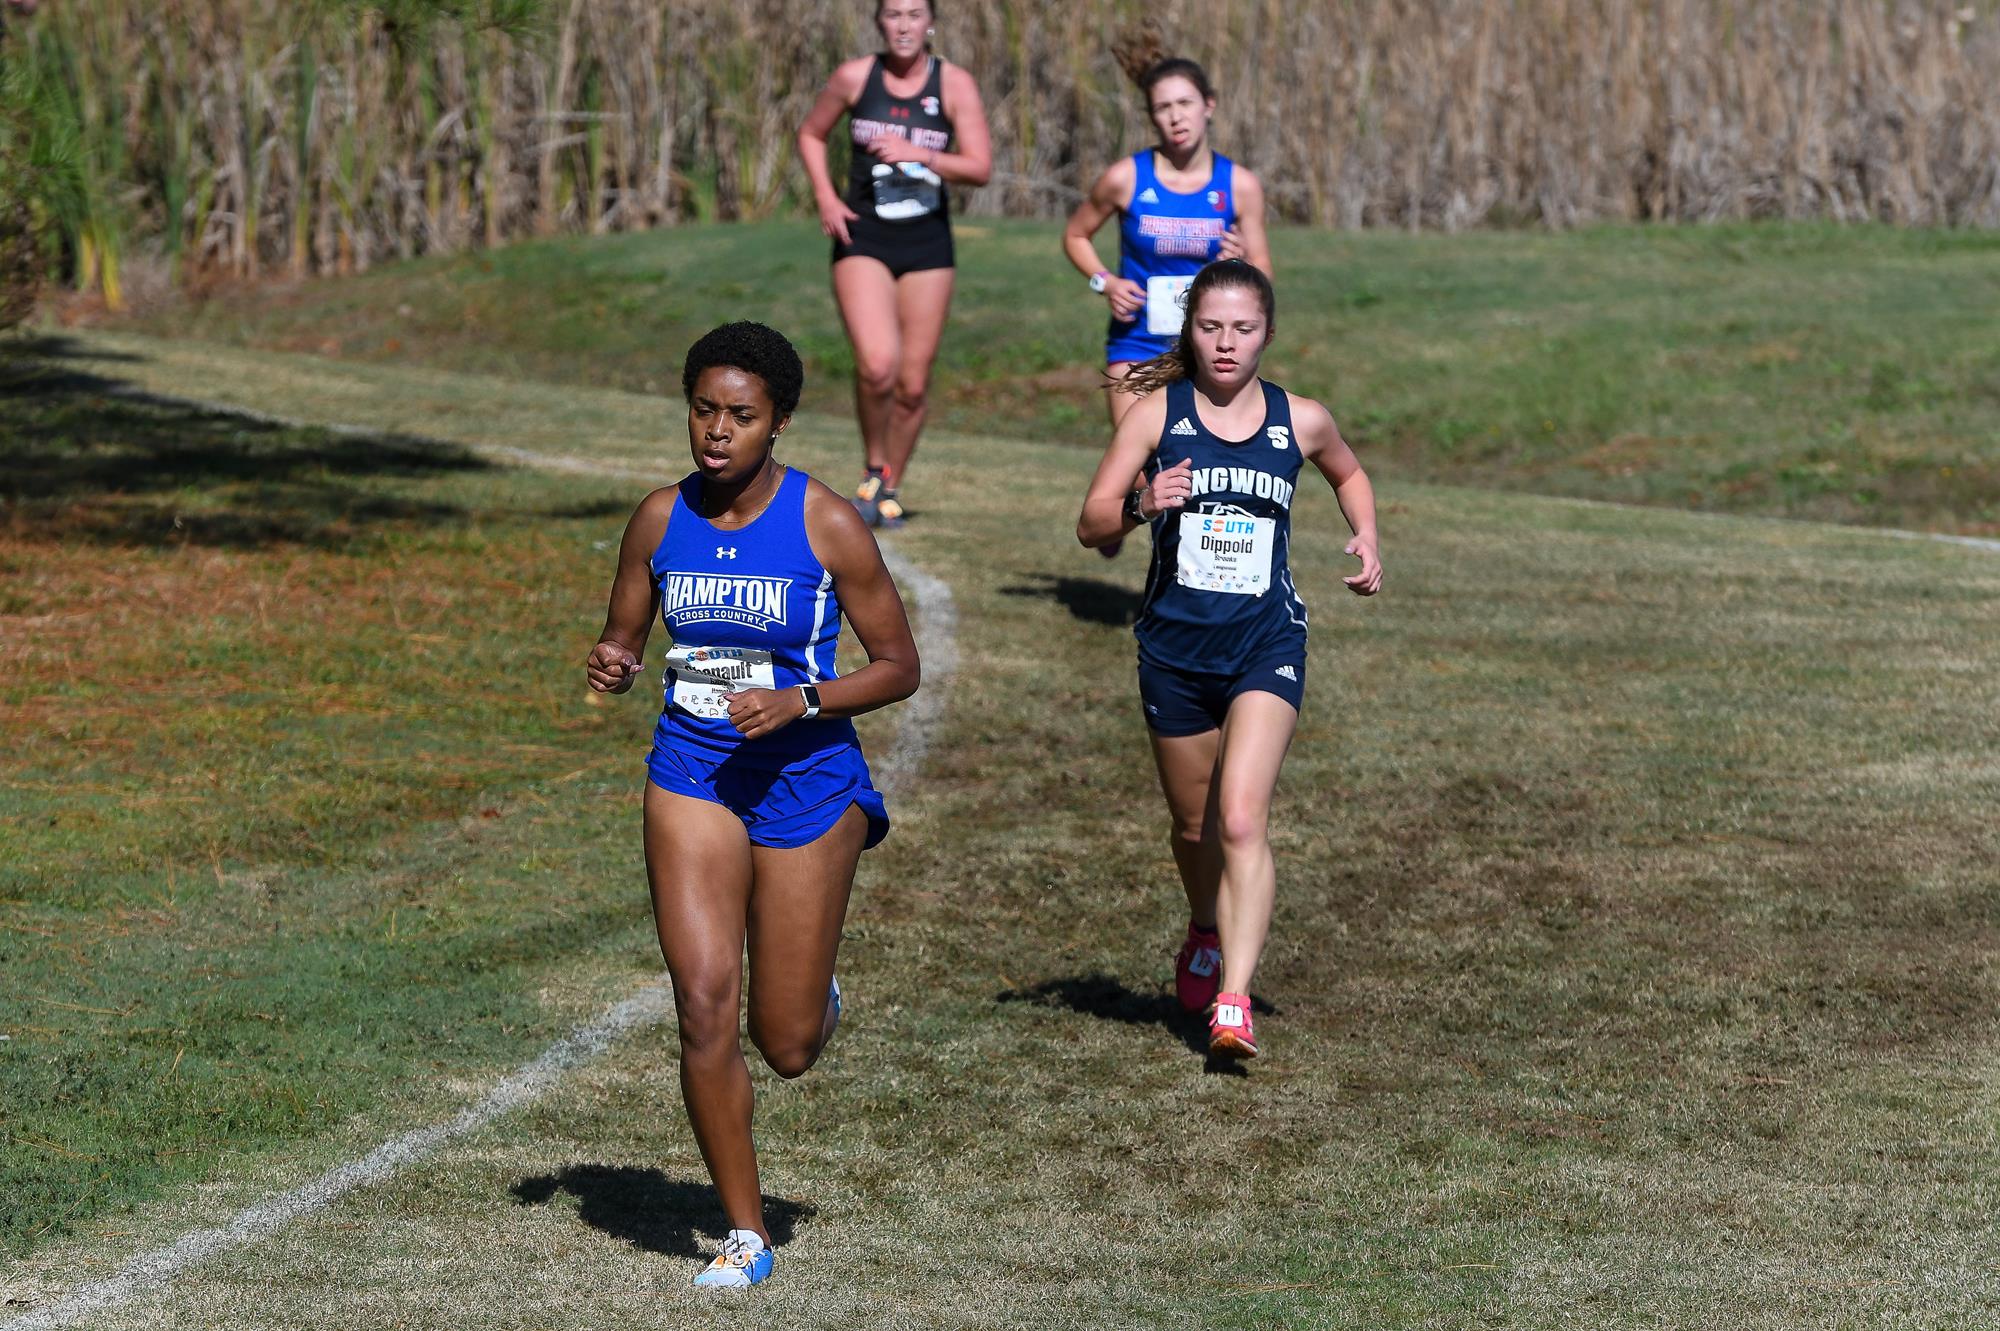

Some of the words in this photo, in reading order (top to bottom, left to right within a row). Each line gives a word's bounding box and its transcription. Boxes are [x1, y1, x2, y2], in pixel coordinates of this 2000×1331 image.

[1191, 466, 1293, 511] NGWOOD
[1200, 535, 1254, 555] Dippold
[666, 575, 783, 620] HAMPTON
[680, 610, 710, 621] CROSS
[713, 610, 761, 625] COUNTRY
[684, 661, 753, 681] nault
